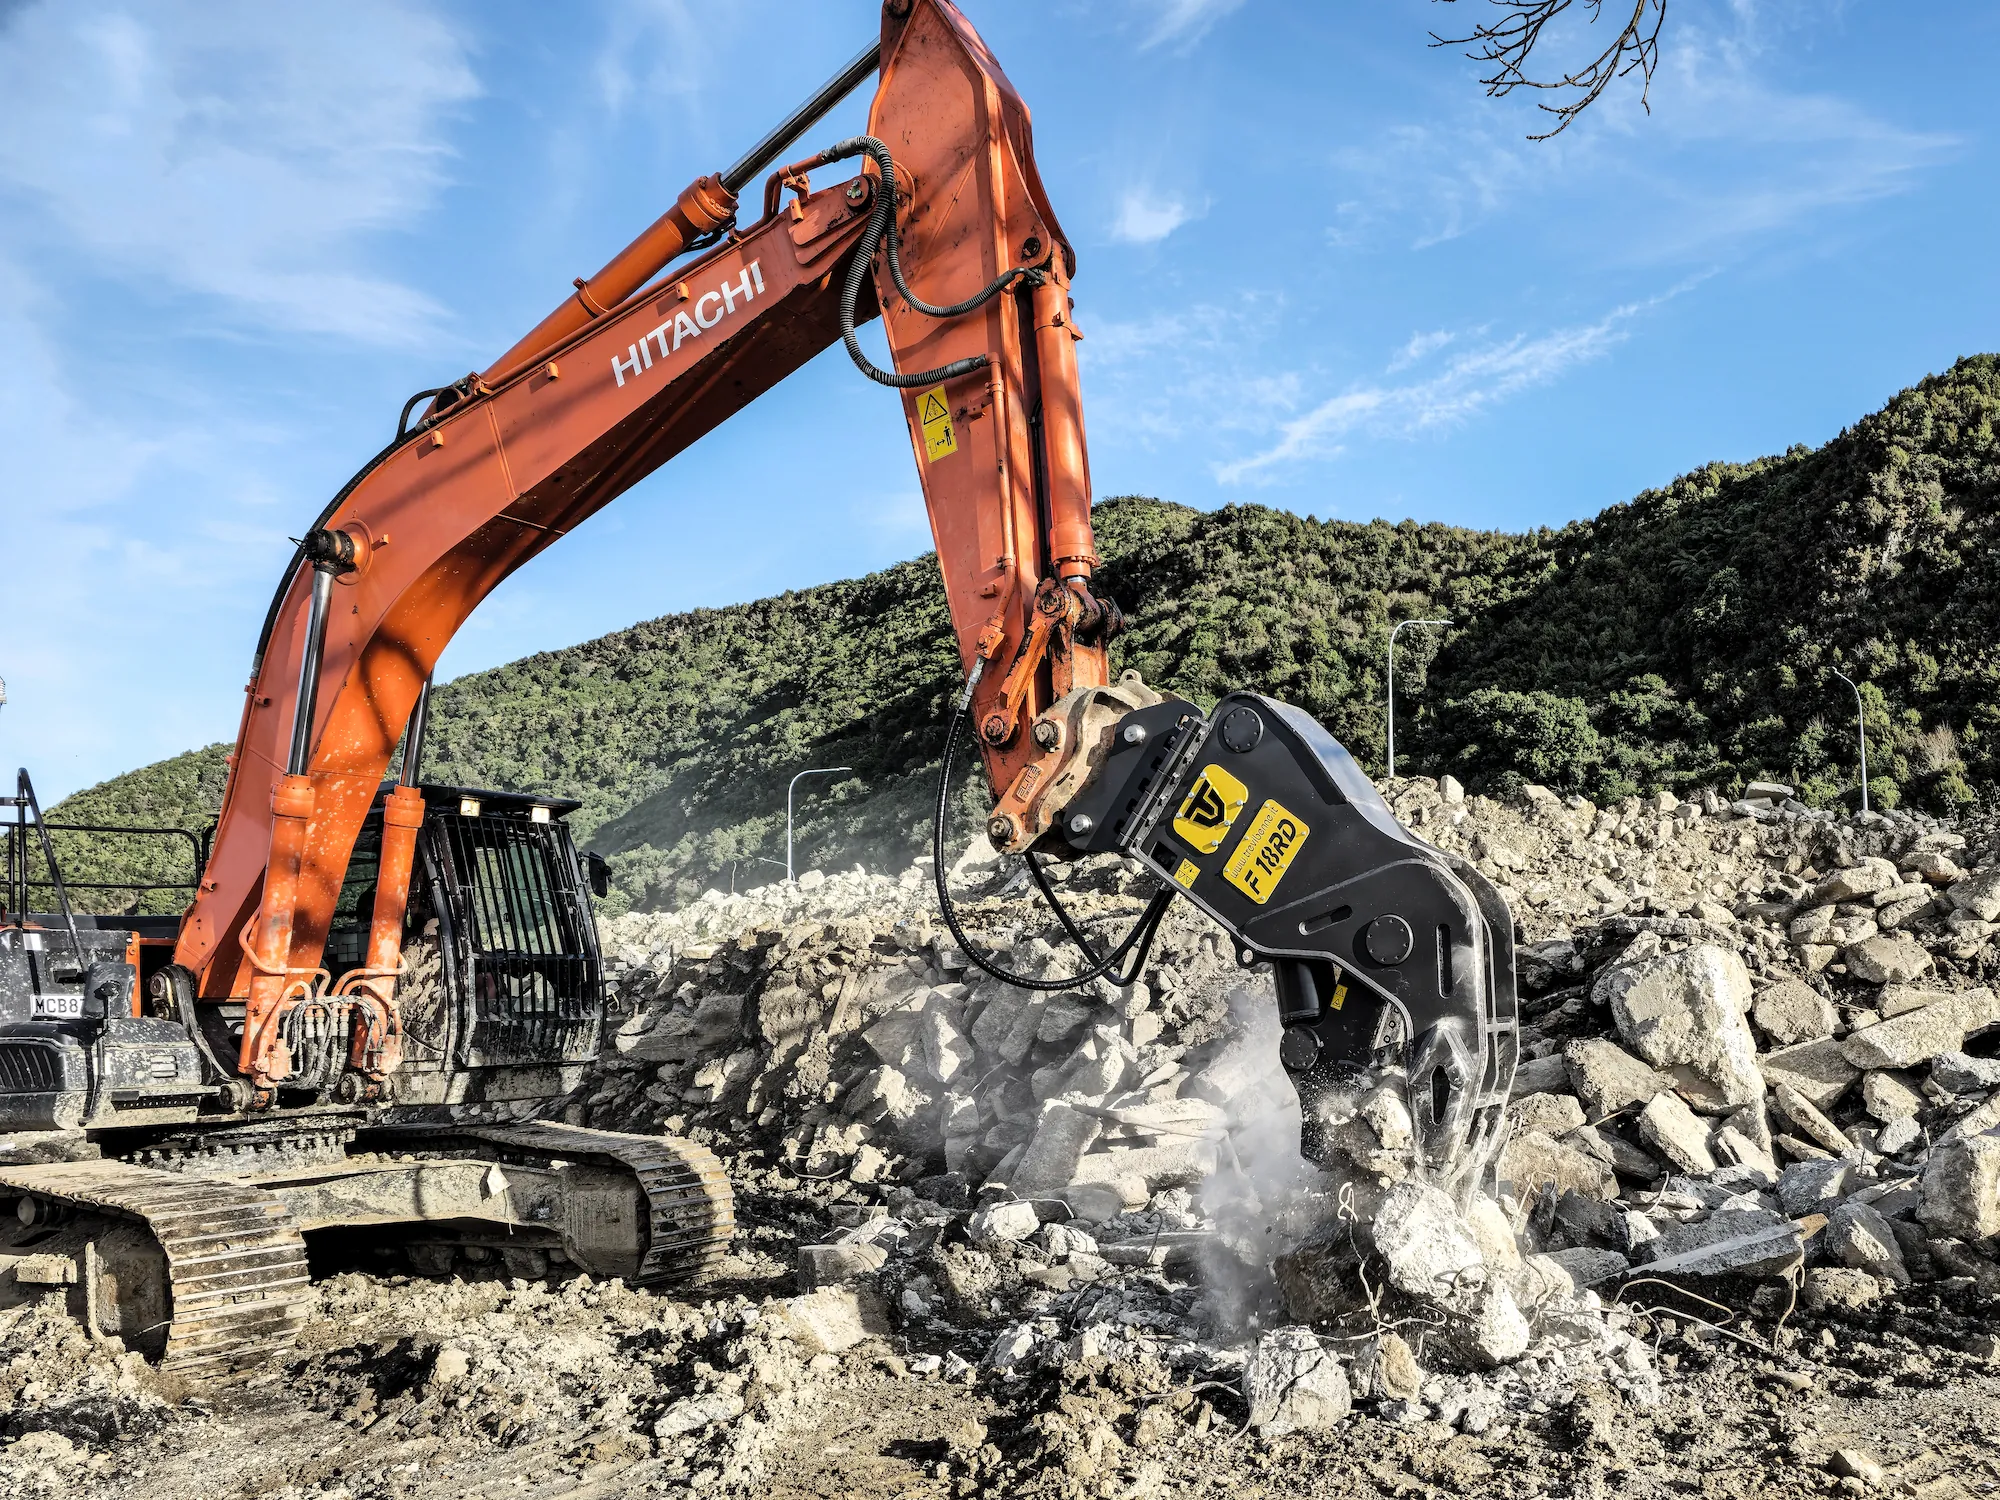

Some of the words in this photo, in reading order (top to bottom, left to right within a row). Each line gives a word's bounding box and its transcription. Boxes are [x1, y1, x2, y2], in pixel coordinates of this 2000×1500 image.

[611, 260, 766, 388] HITACHI
[1231, 806, 1279, 879] www.trevibenne.it
[1244, 869, 1260, 895] F
[1256, 818, 1296, 876] 18RD
